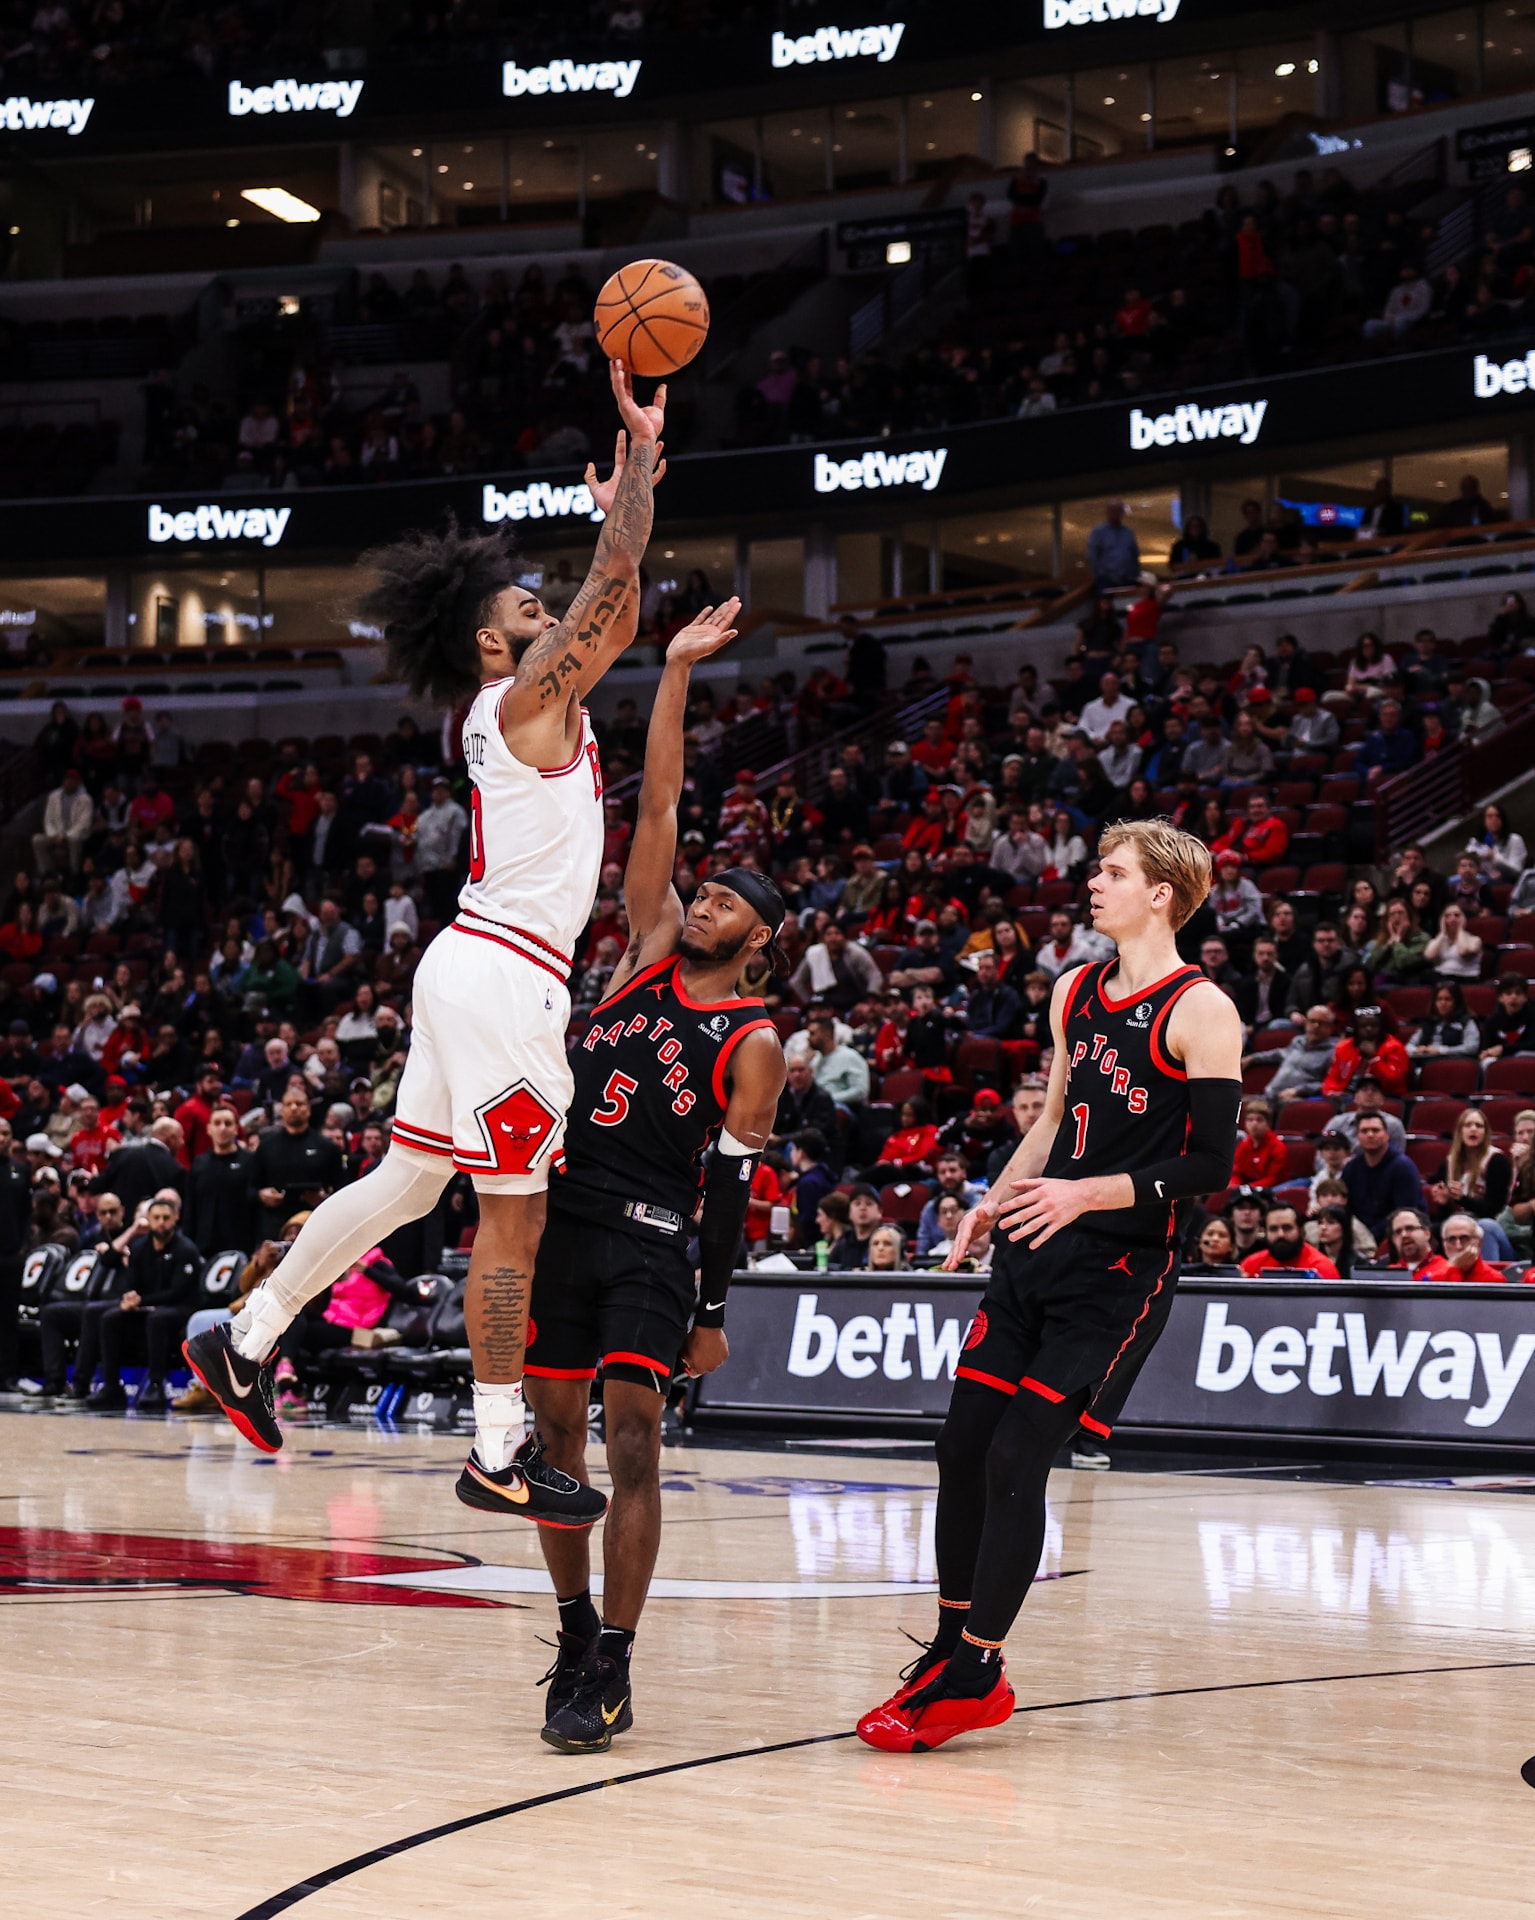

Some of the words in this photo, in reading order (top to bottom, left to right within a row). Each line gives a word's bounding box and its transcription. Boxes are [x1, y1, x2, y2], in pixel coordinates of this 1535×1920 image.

[1044, 0, 1181, 29] betway
[772, 23, 905, 68] betway
[229, 79, 364, 117] betway
[504, 59, 641, 98] betway
[1130, 401, 1267, 449] betway
[815, 449, 948, 493] betway
[150, 504, 291, 546] betway
[464, 733, 487, 766] HITE
[697, 1022, 711, 1036] Sun
[709, 1030, 722, 1042] Life
[1126, 1019, 1139, 1028] Sun
[1138, 1021, 1149, 1029] Life
[583, 1013, 696, 1116] RAPTORS
[1064, 1033, 1149, 1114] PTORS
[590, 1069, 639, 1127] 5
[1071, 1102, 1090, 1160] 1
[787, 1294, 974, 1381] betw
[1196, 1302, 1535, 1428] betway
